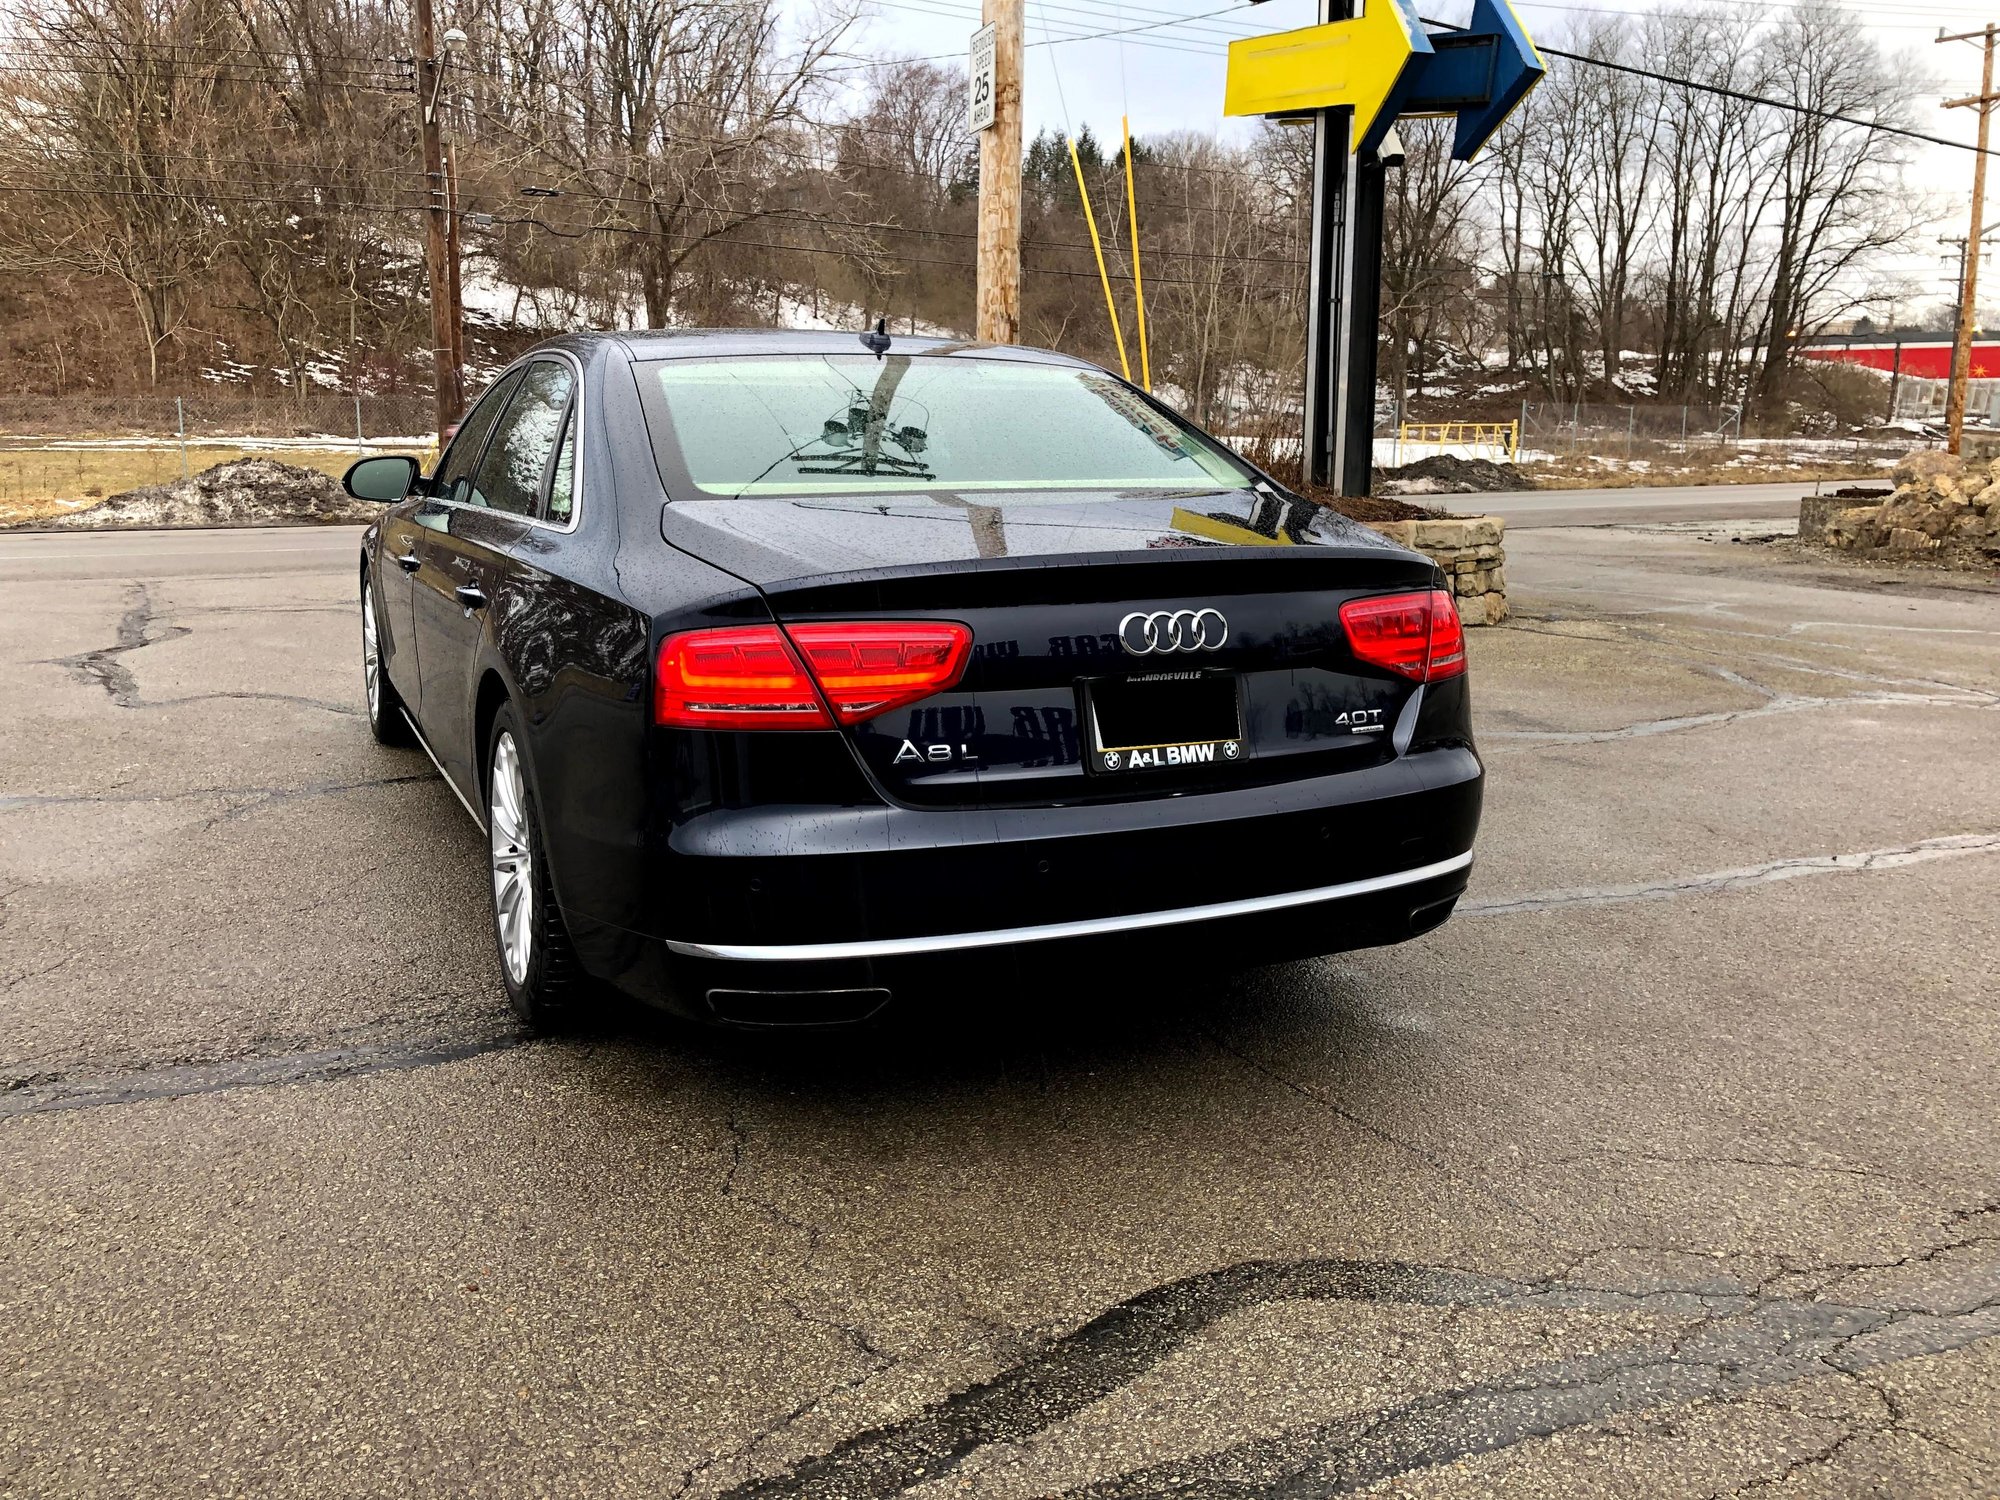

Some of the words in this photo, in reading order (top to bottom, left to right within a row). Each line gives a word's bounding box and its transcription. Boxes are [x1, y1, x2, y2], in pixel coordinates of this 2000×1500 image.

[976, 50, 991, 72] SPEED
[974, 71, 989, 106] 25
[973, 104, 990, 125] AHEAD
[1335, 709, 1382, 725] 4.0T
[1128, 748, 1166, 769] A&L
[1166, 743, 1215, 765] BMW
